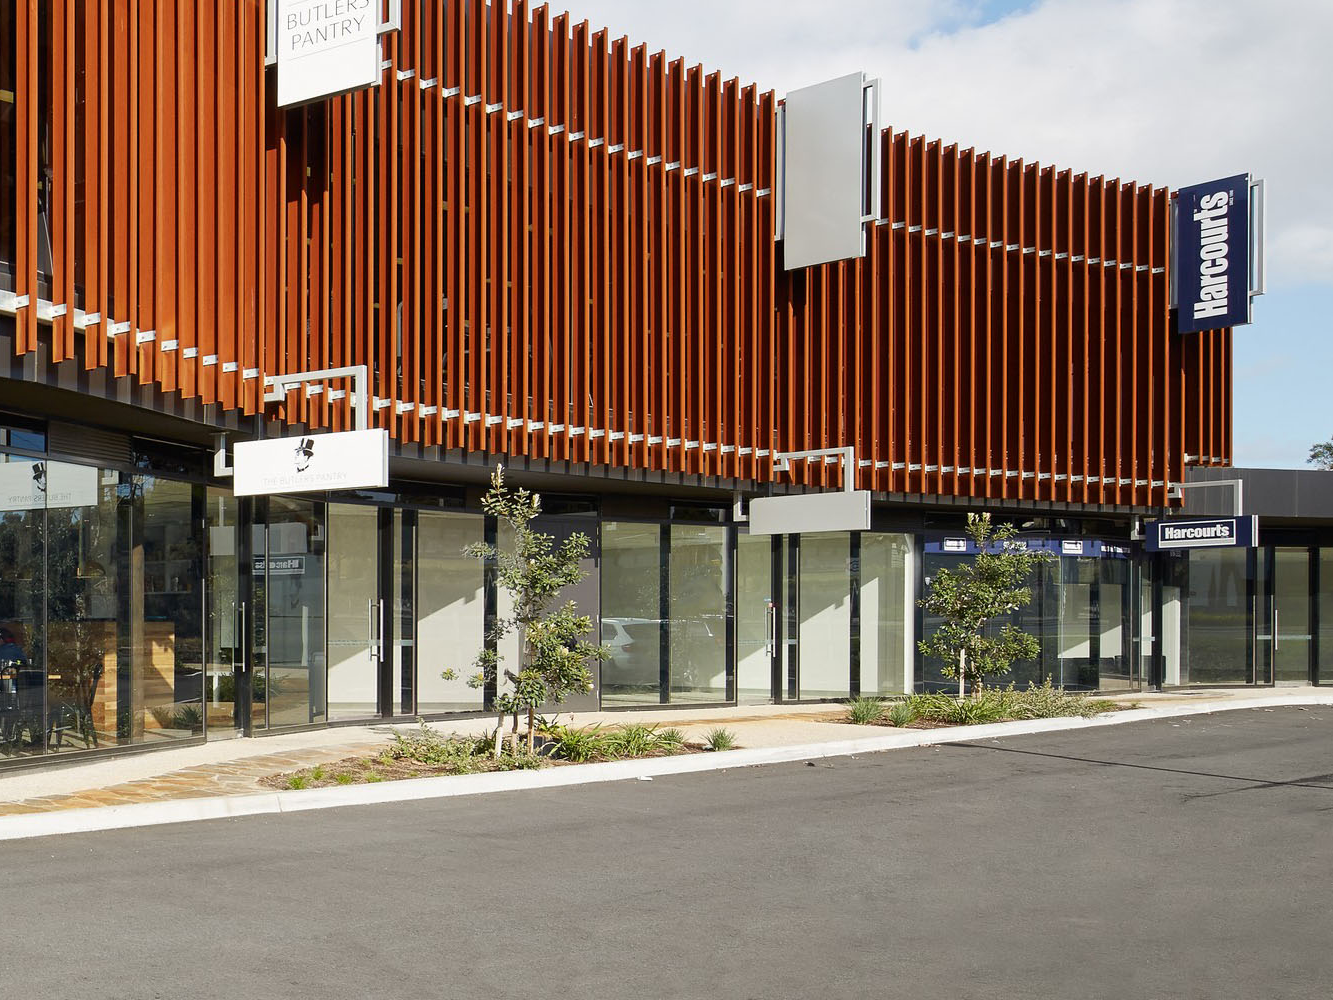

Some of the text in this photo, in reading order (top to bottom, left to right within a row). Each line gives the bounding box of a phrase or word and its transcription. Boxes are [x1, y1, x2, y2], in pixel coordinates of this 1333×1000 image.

[291, 14, 365, 50] PANTRY
[1193, 190, 1229, 320] Harcourts
[316, 472, 348, 482] PANTRY
[1164, 524, 1230, 540] Harcourts
